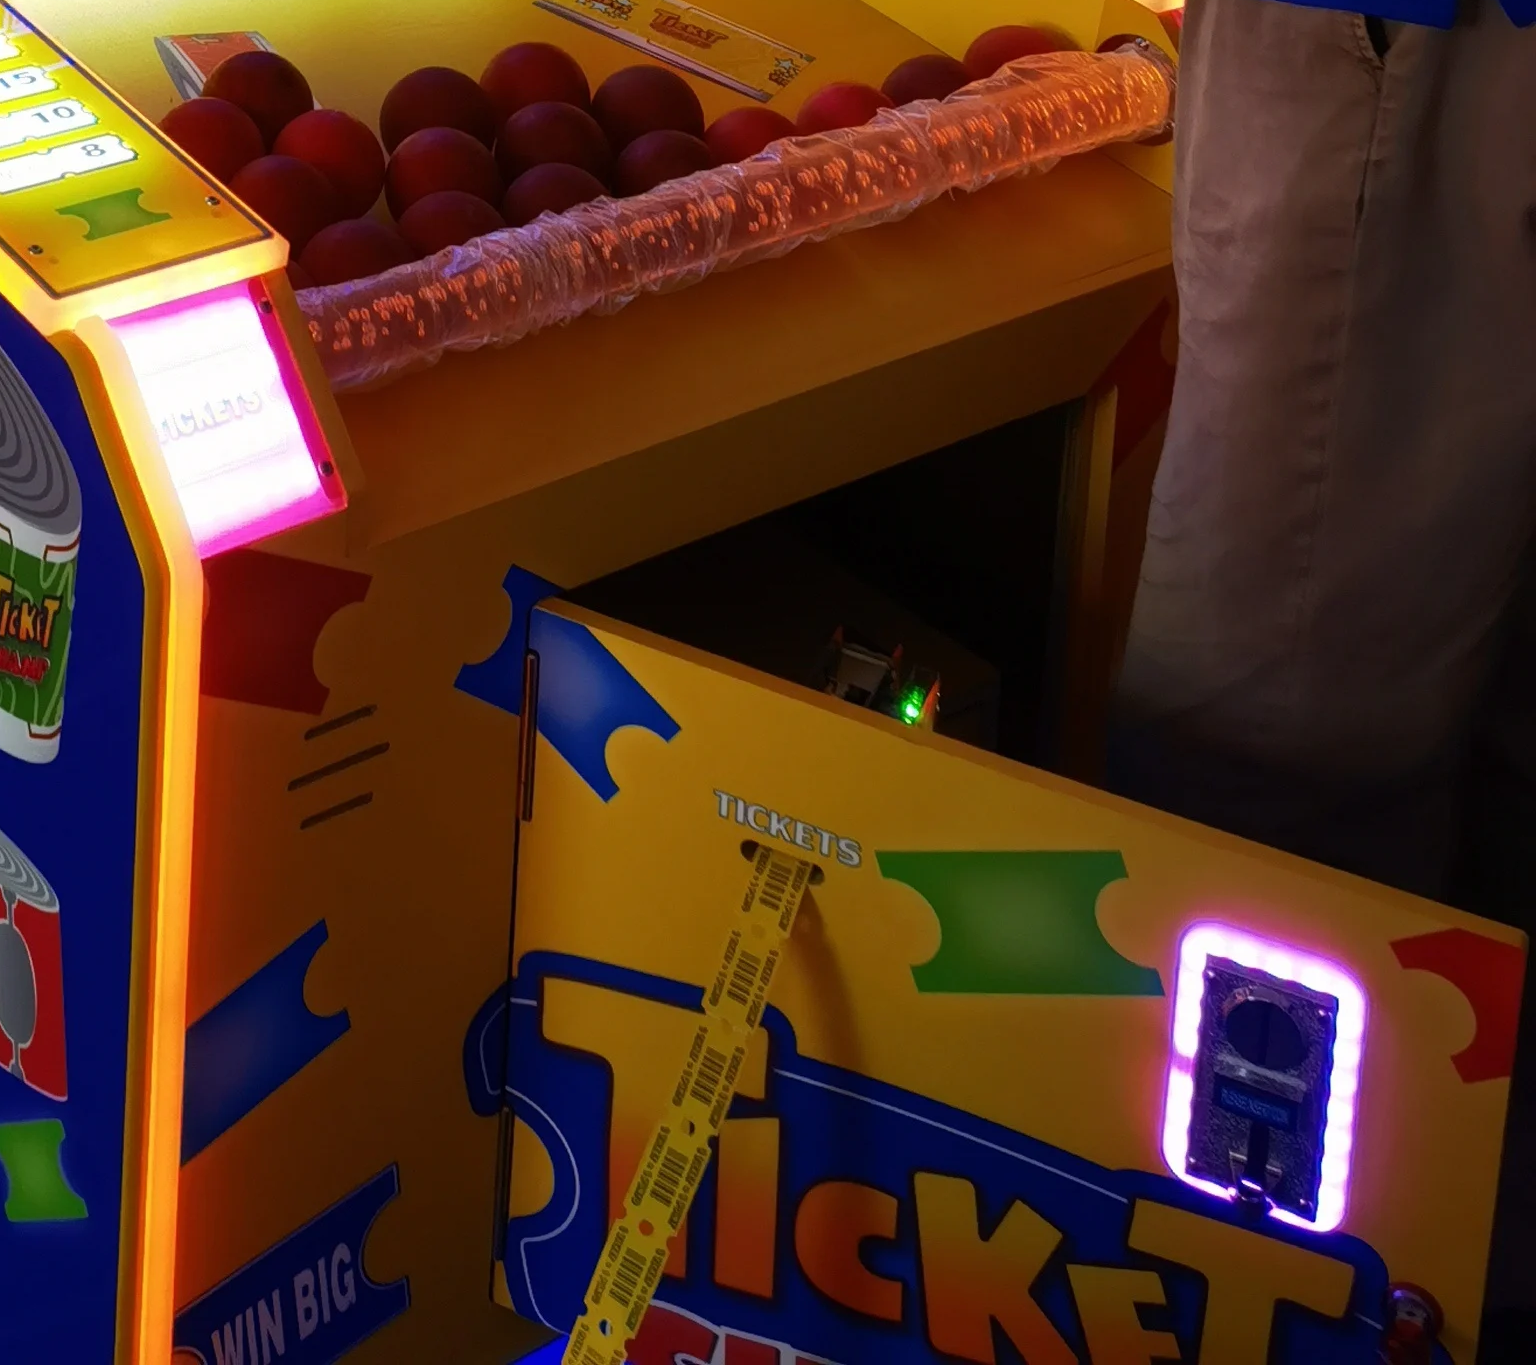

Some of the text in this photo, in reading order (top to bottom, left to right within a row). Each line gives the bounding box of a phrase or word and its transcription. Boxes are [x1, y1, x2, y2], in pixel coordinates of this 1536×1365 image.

[32, 105, 77, 124] 10
[81, 143, 107, 157] 8
[713, 787, 863, 868] TICKETS
[211, 1242, 357, 1365] WIN BIG
